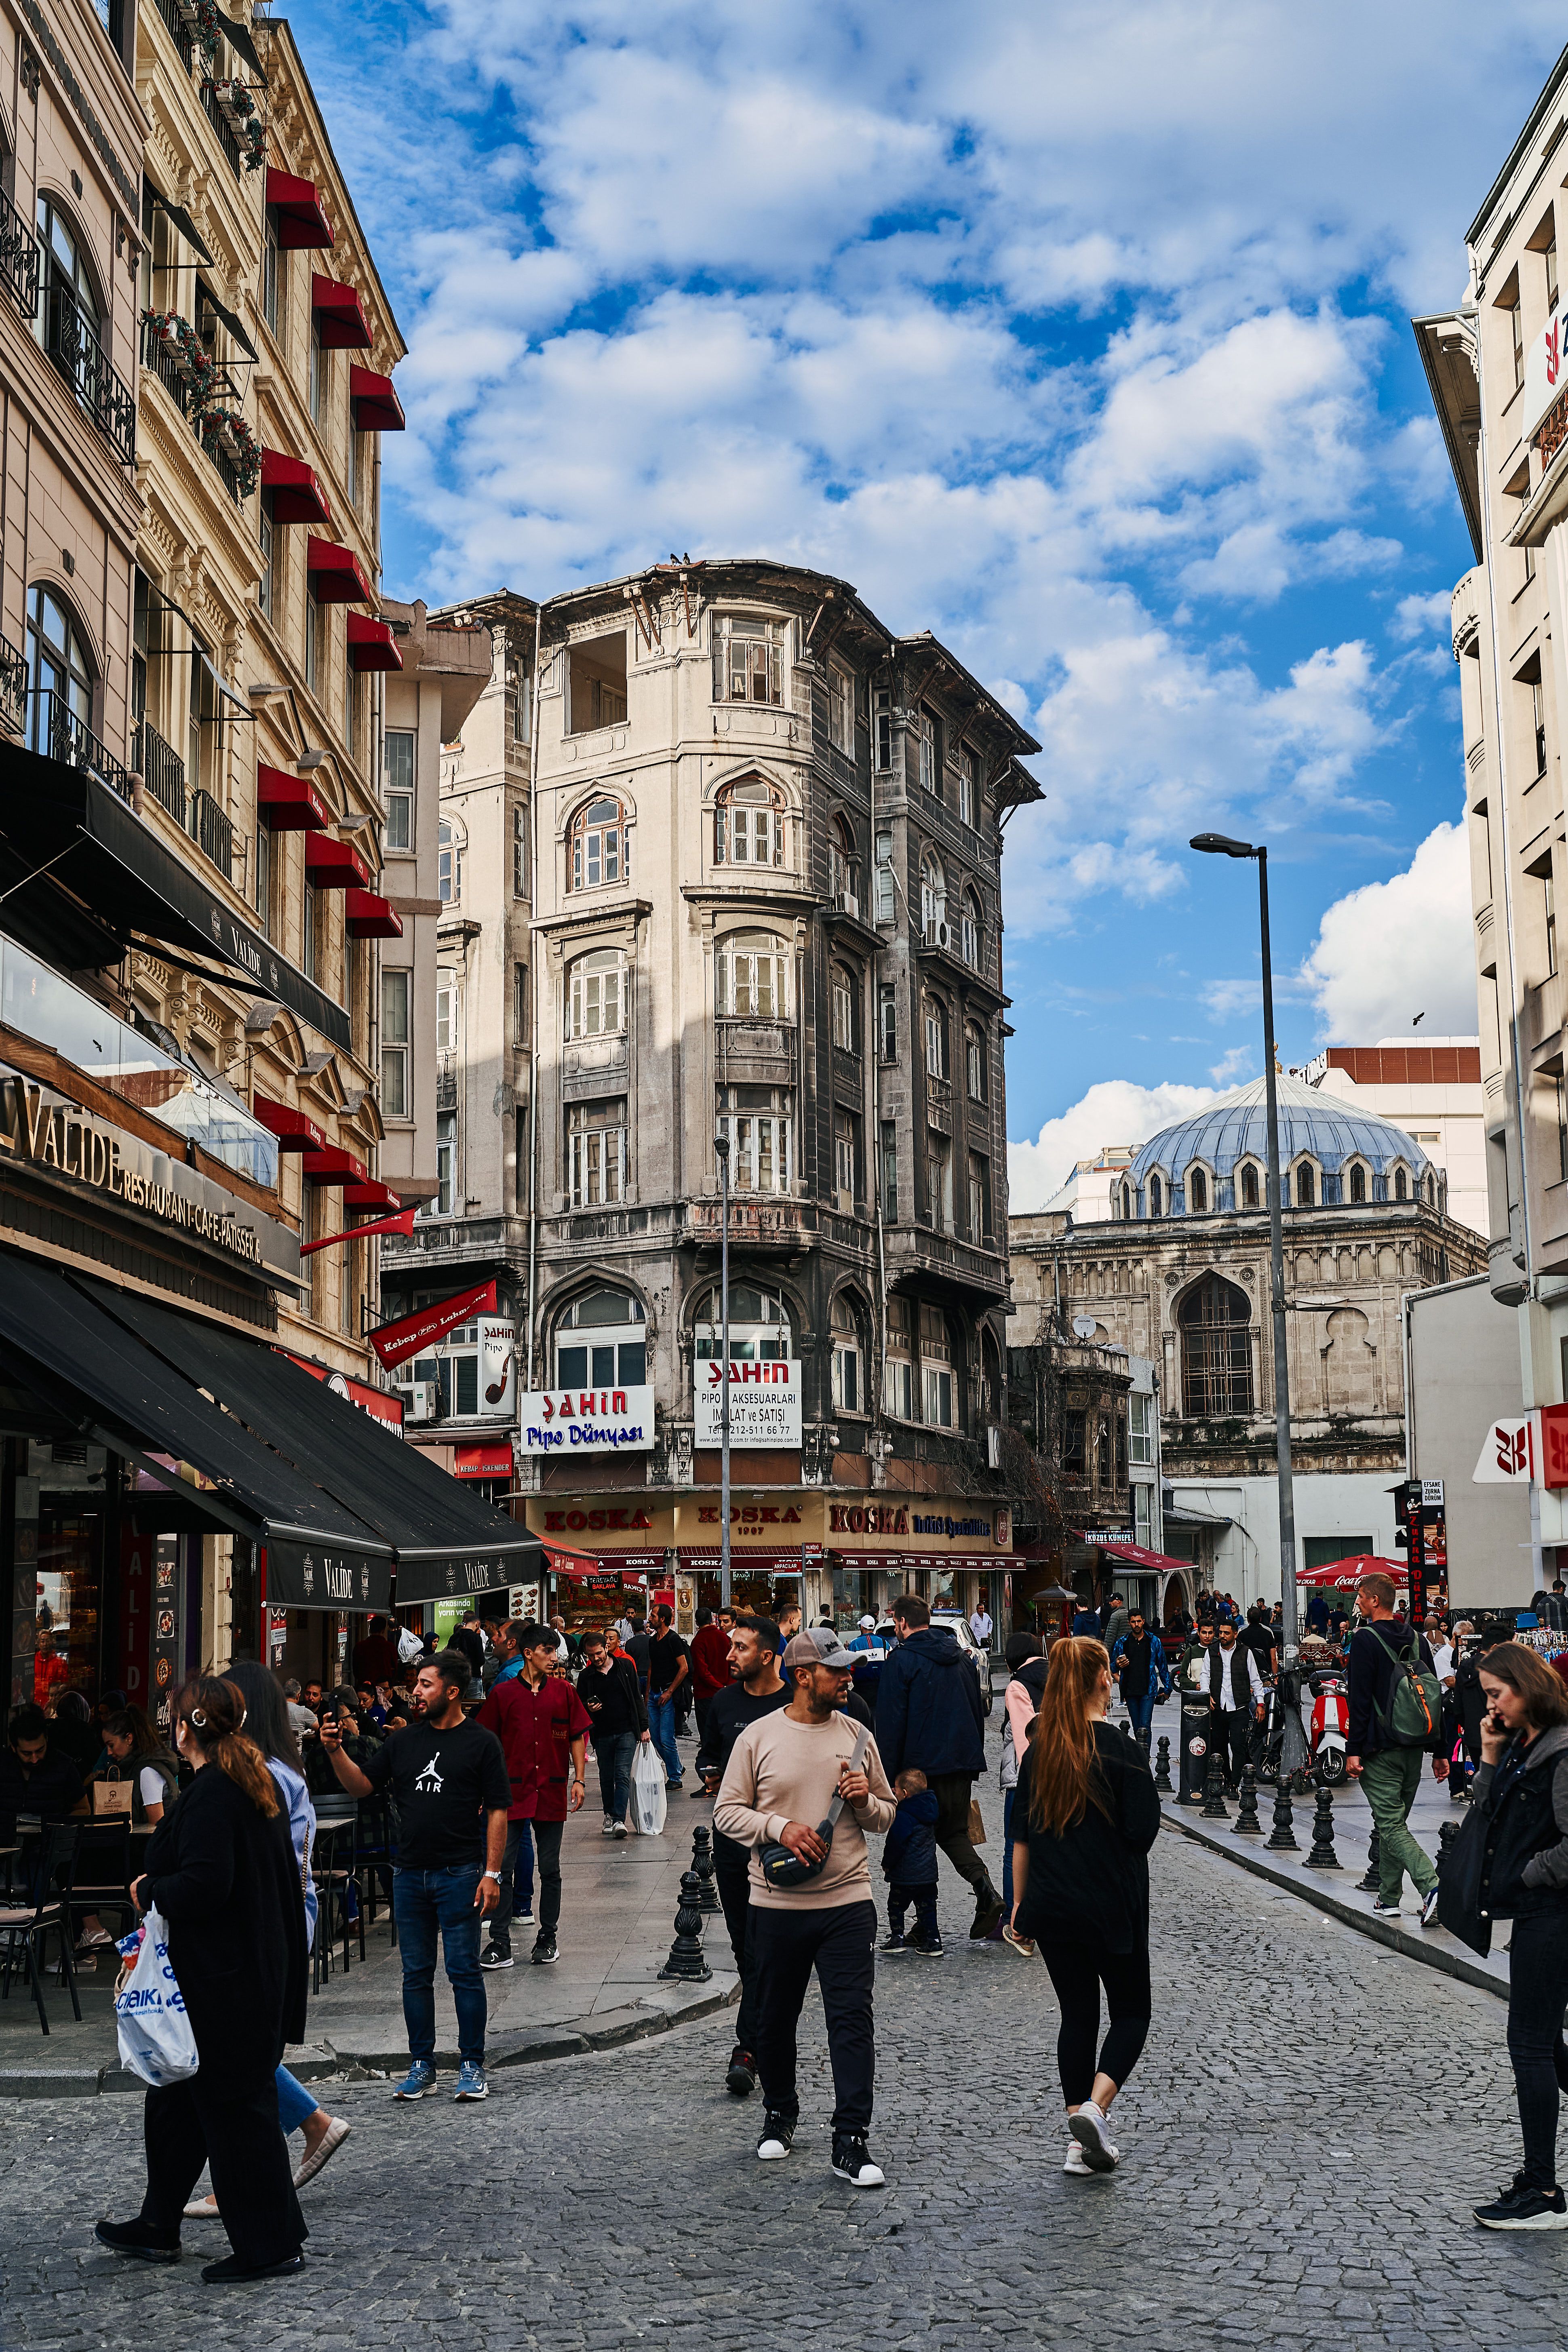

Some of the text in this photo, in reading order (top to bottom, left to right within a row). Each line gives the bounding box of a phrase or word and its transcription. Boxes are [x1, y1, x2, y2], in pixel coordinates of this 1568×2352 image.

[312, 793, 323, 818] Kebap
[231, 926, 261, 977] VALİDE
[310, 1122, 321, 1144] Kebap
[384, 1293, 487, 1352] Kebap Lahmun
[484, 1342, 502, 1354] Pipo
[702, 1390, 796, 1404] PİPO AKSESUARLARI
[713, 1405, 785, 1426] İMLAT ve SATIŞI
[526, 1423, 644, 1450] Pipo Dünyası
[729, 1426, 763, 1434] 212-511
[767, 1426, 777, 1434] 66
[780, 1426, 790, 1434] 77
[483, 1463, 509, 1472] İSKENDER
[544, 1508, 652, 1530] KOSKA
[698, 1507, 801, 1523] KOSKA
[830, 1505, 909, 1534] KOSKA
[738, 1526, 764, 1535] 1907
[1109, 1533, 1131, 1541] KÜNEFE
[324, 1558, 353, 1599] VALİDE
[464, 1561, 490, 1590] VALİDE
[438, 1599, 471, 1607] Arkasında
[438, 1609, 455, 1618] yarın
[415, 1781, 442, 1793] AIR
